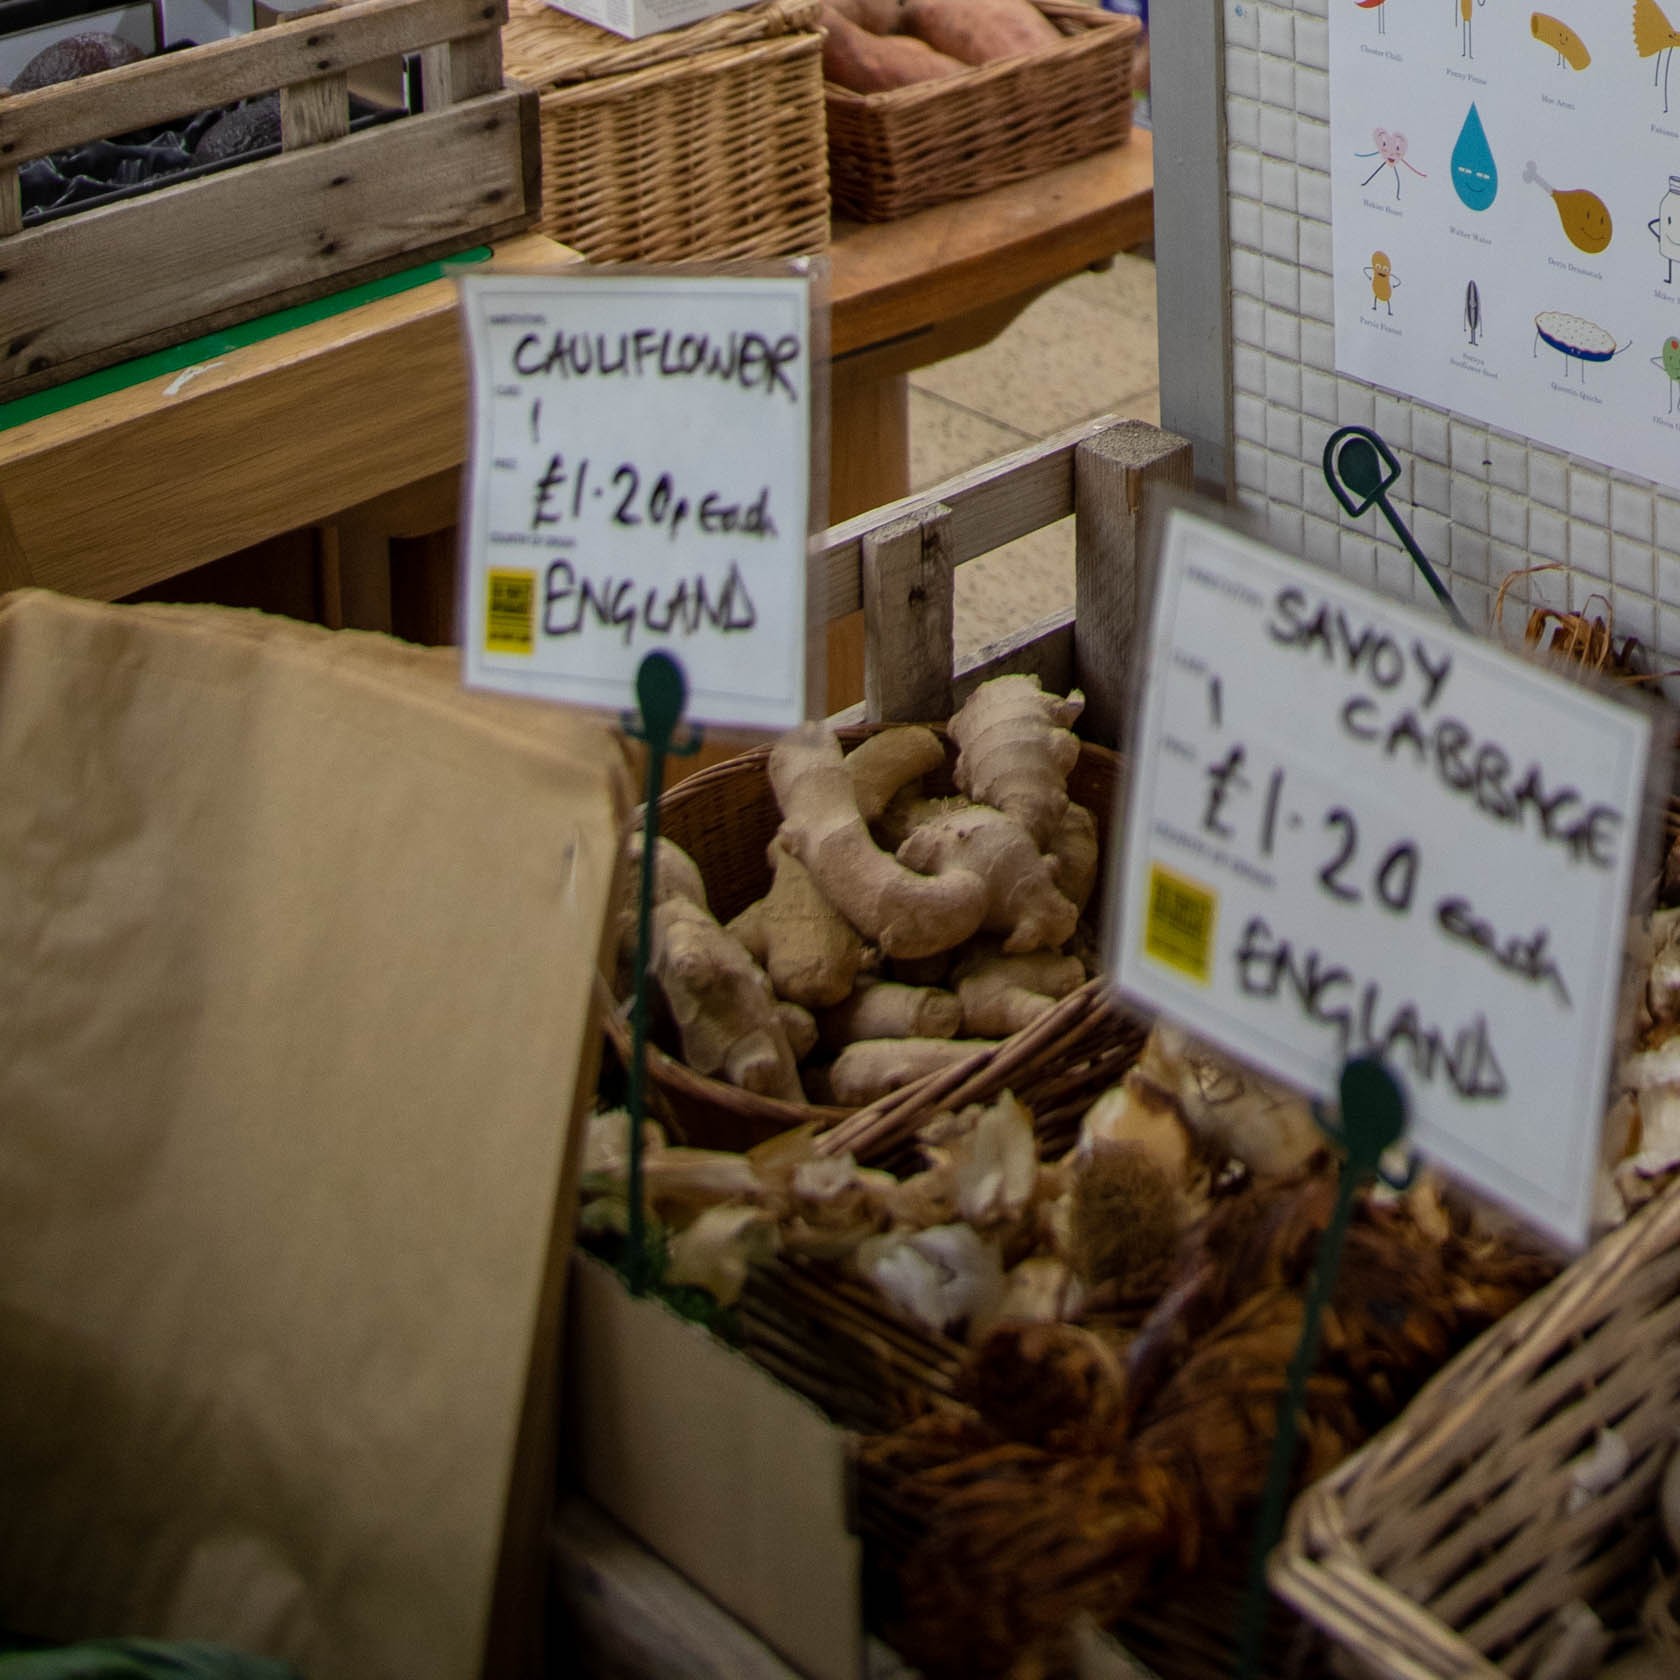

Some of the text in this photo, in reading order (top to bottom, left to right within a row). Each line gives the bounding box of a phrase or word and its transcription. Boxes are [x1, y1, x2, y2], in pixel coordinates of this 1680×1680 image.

[513, 328, 800, 403] CAULIFLOWER
[542, 558, 757, 645] ENGLAND
[1268, 587, 1453, 709] SAVOY
[1340, 694, 1624, 871] CABBAGE
[1234, 914, 1508, 1102] ENGLAND
